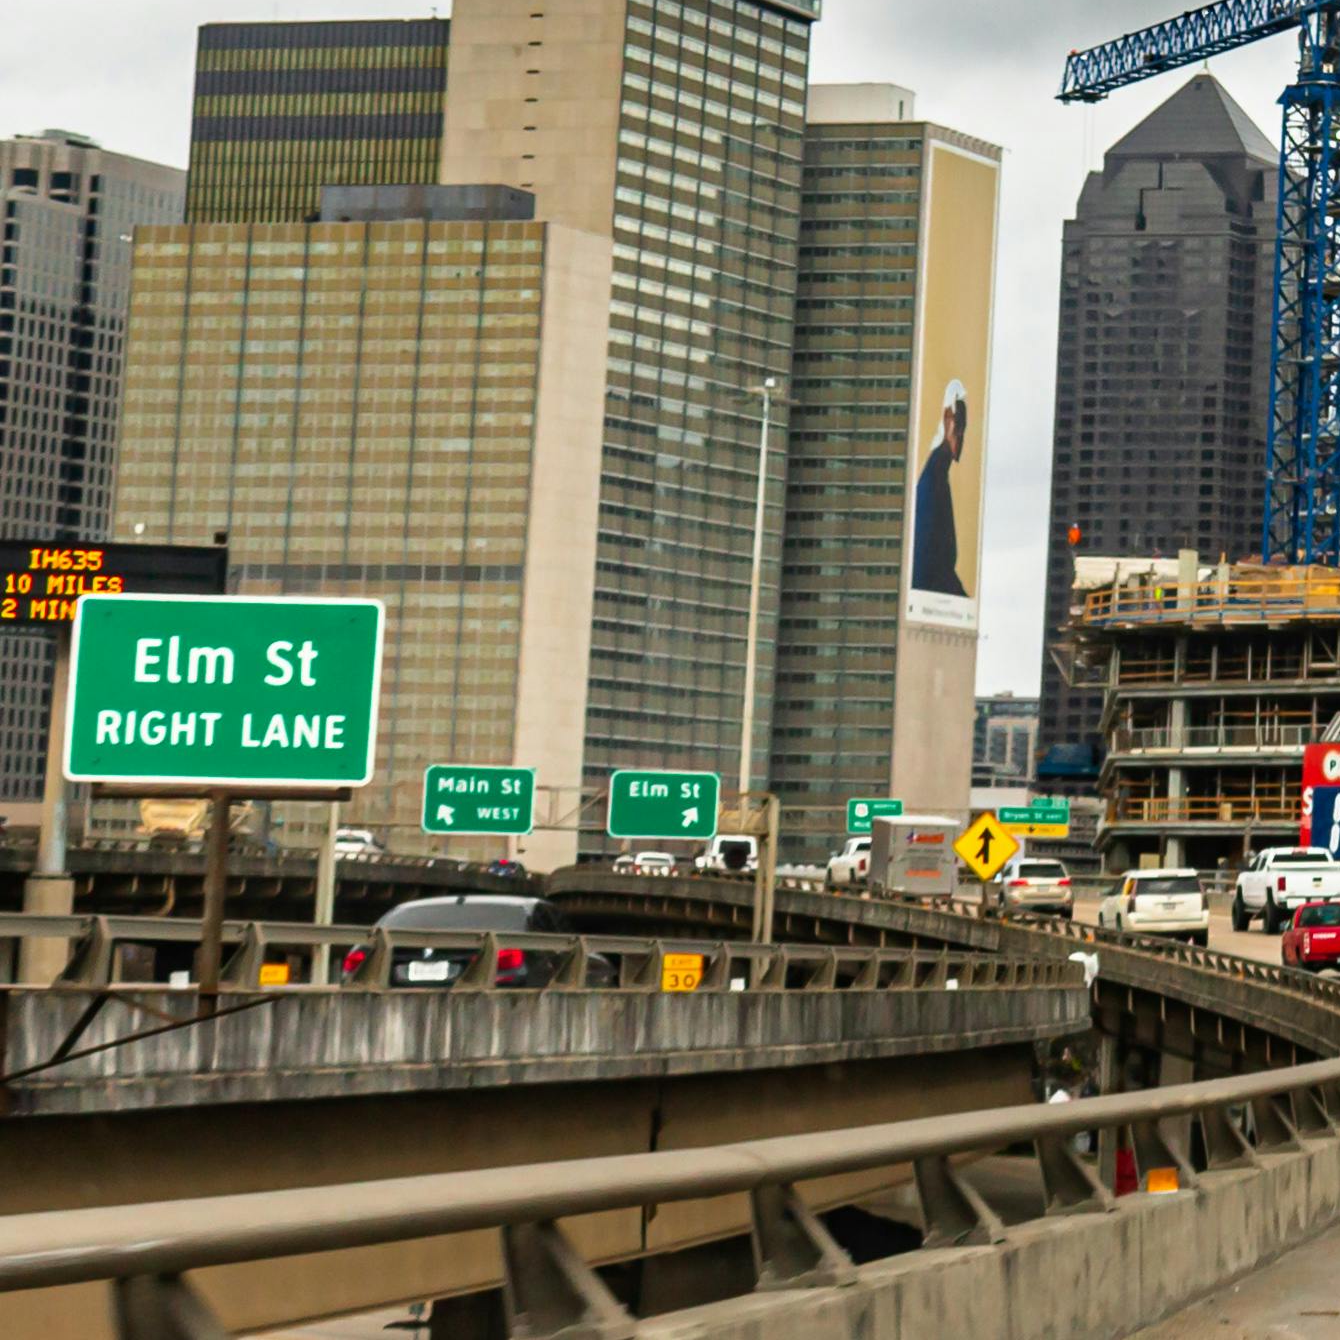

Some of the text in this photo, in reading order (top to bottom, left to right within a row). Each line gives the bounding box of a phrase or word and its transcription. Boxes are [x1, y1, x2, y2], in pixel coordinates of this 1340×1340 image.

[29, 548, 103, 571] IH635
[5, 573, 123, 594] 10 MILES
[133, 634, 319, 687] Elm St
[95, 709, 347, 750] RIGHT LANE
[436, 776, 521, 795] Main St
[628, 781, 701, 799] Elm St
[476, 806, 519, 821] WEST
[668, 973, 696, 989] 30
